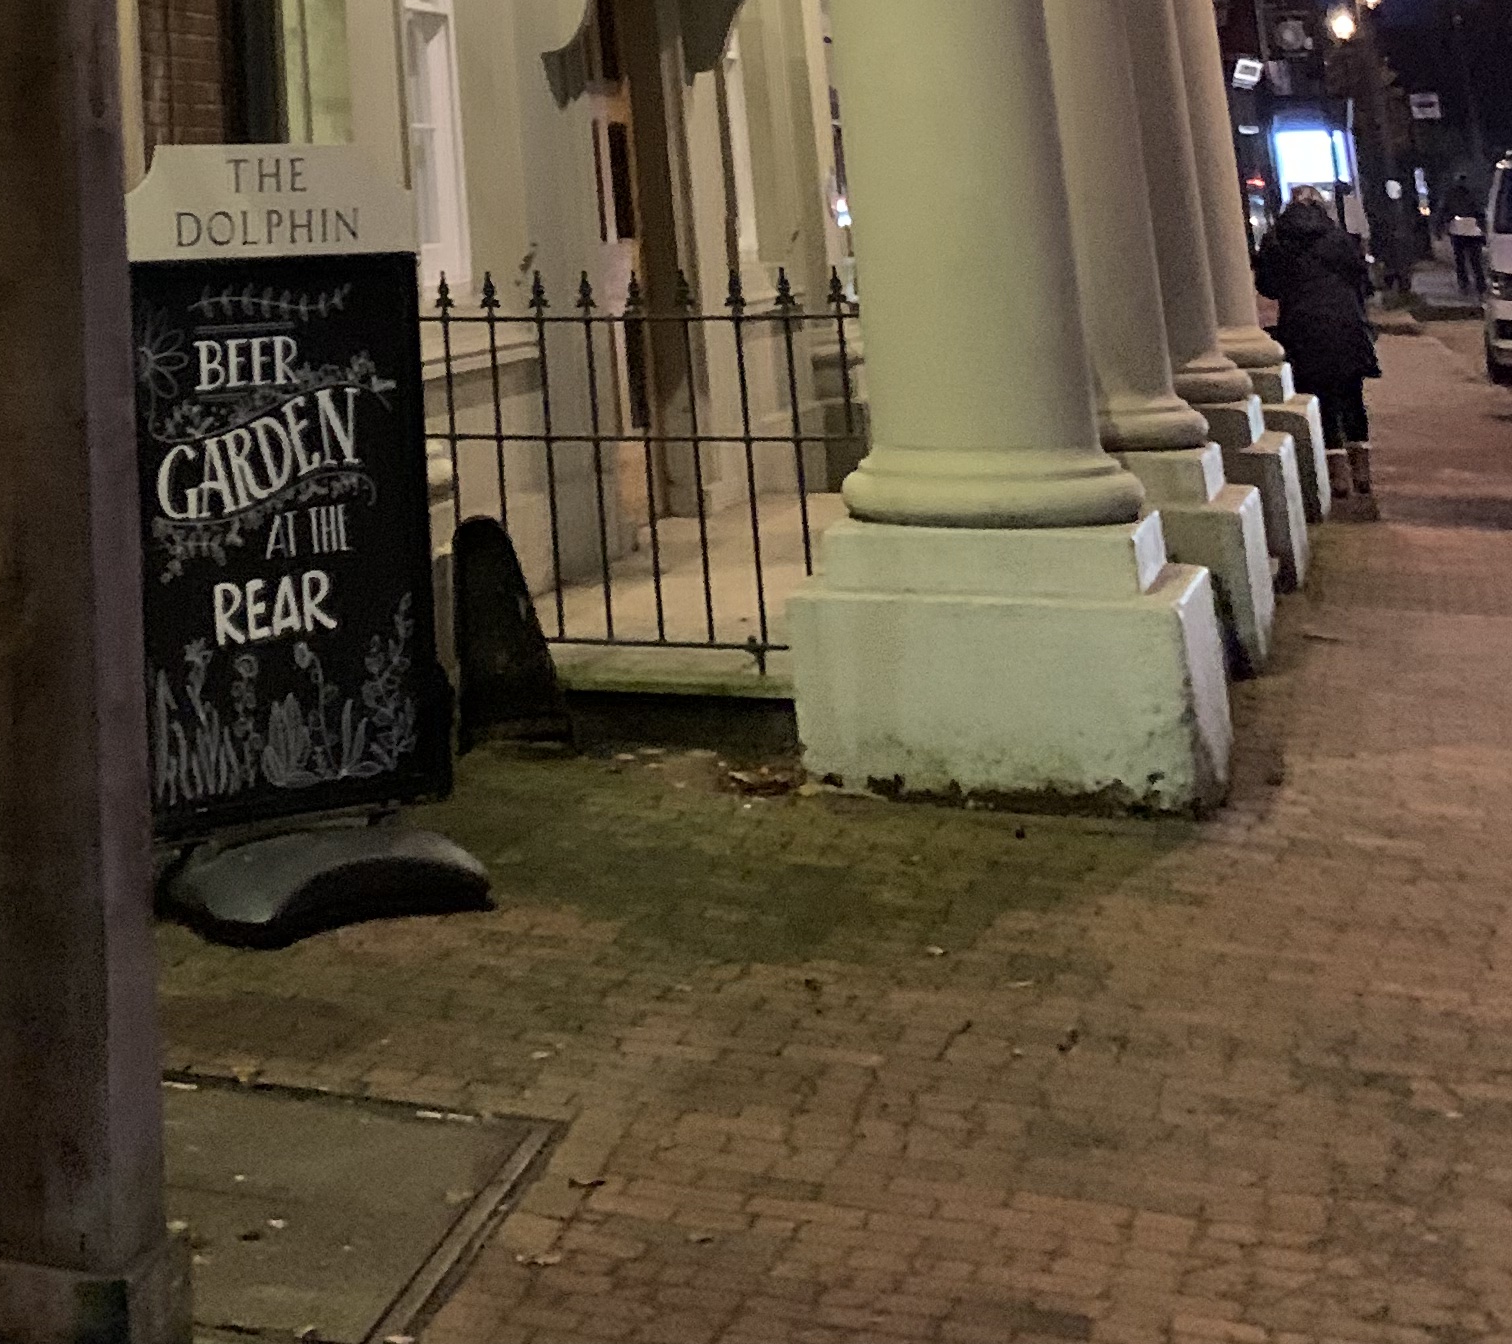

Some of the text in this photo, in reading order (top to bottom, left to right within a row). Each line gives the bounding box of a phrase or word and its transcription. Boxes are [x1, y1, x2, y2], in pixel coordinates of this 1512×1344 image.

[225, 157, 308, 194] THE
[175, 207, 360, 247] DOLPHIN
[193, 335, 300, 392] BEER
[157, 387, 362, 520] GARDEN
[265, 503, 355, 561] AT THE
[213, 569, 338, 646] REAR
